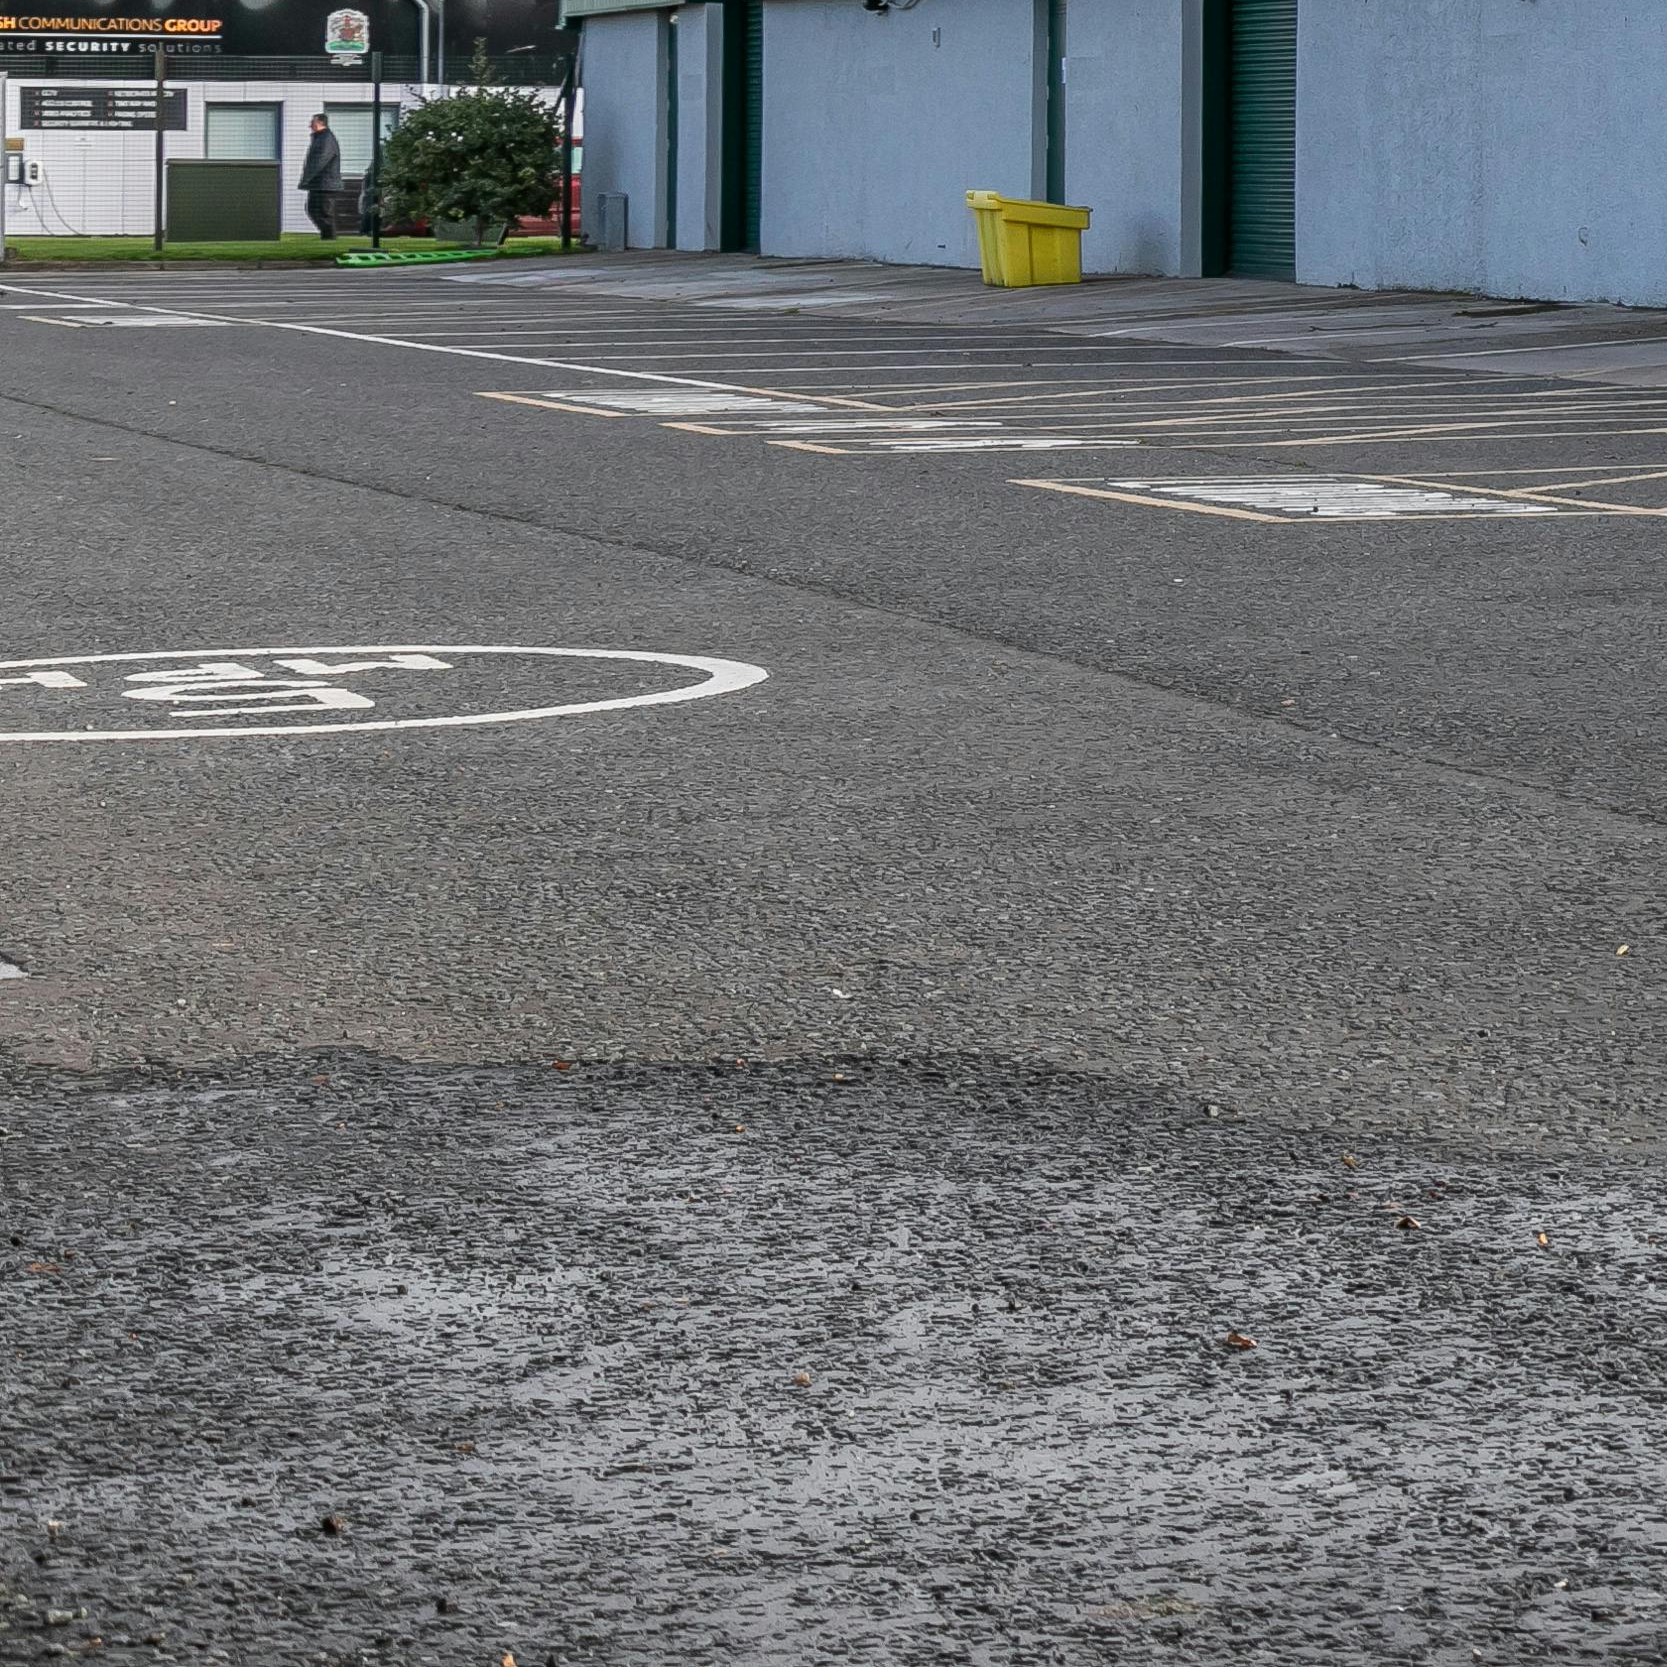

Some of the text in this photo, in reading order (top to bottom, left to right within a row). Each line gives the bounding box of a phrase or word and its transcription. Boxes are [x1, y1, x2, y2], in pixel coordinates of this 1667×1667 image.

[19, 17, 162, 31] COMMUNICATIONS
[164, 19, 222, 32] GROUP
[45, 41, 131, 52] SECURITY
